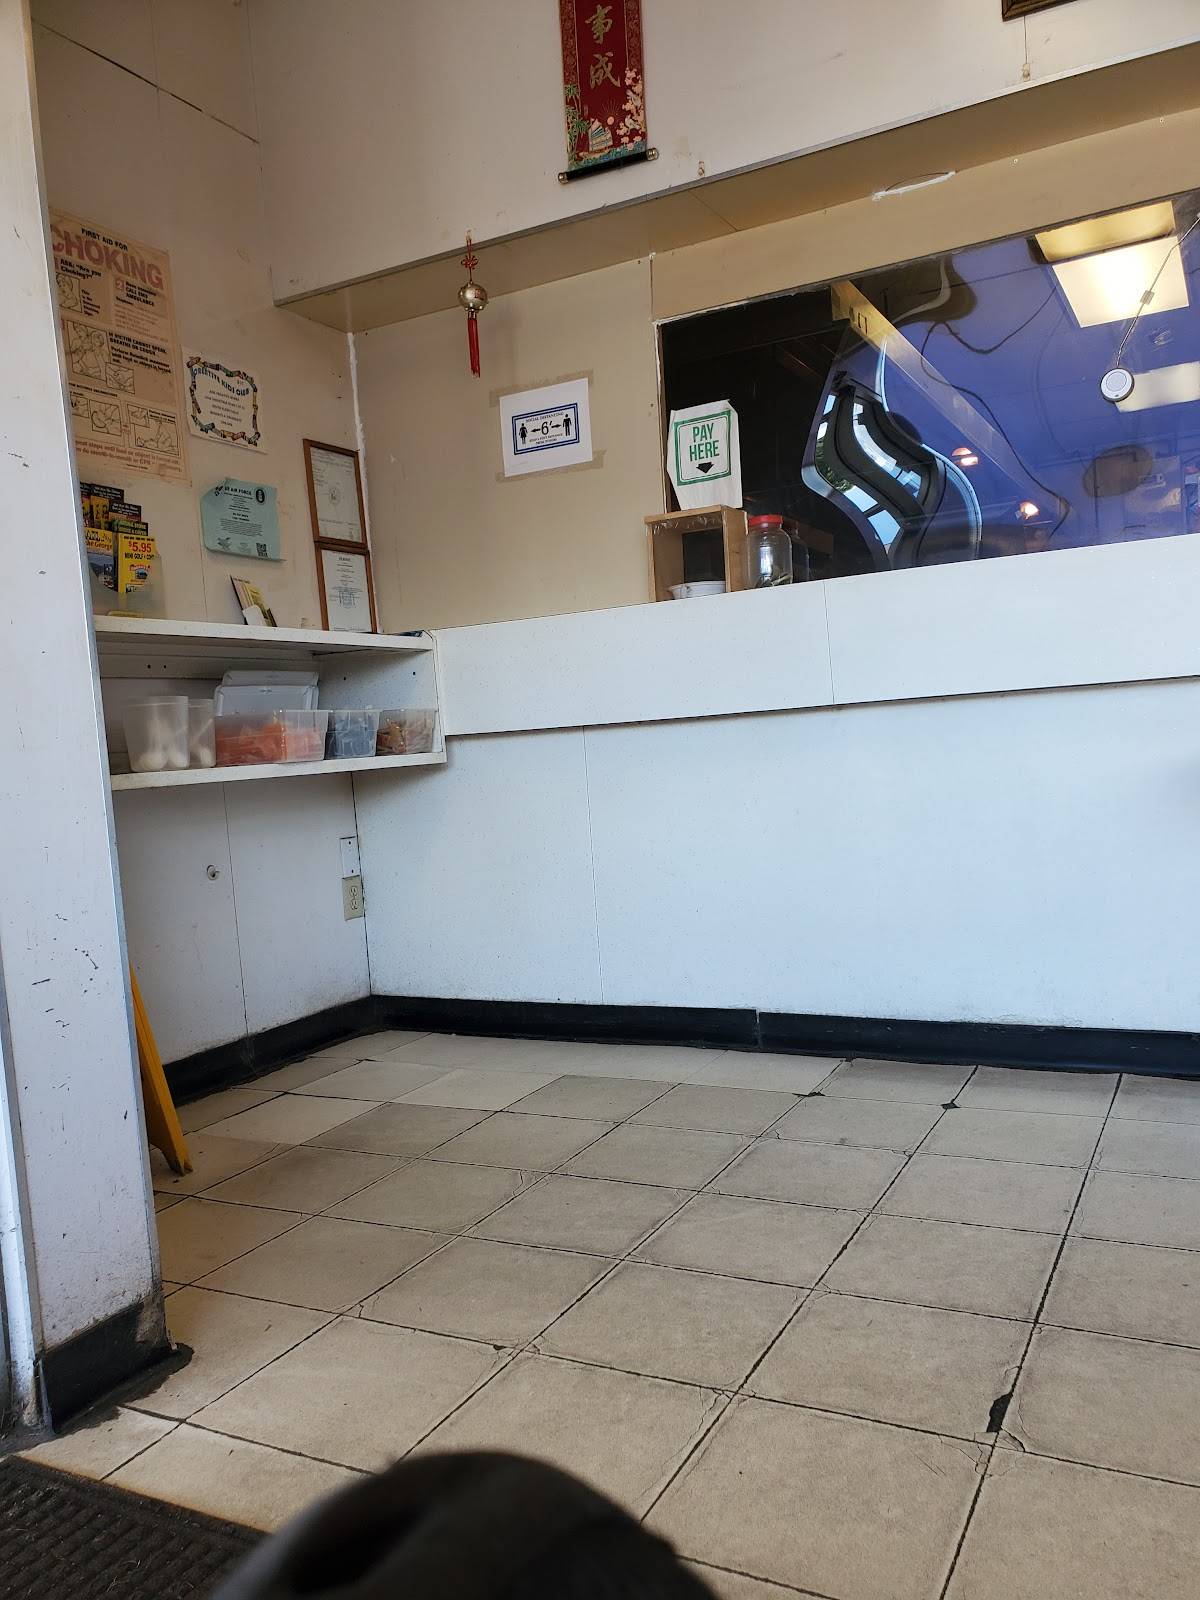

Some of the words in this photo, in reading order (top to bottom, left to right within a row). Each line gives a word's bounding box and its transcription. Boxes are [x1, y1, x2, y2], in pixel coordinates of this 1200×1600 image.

[81, 227, 100, 241] FIRST
[102, 235, 113, 246] AID
[115, 241, 128, 252] FOR
[114, 277, 124, 290] 2
[692, 422, 714, 443] PAY
[689, 439, 720, 462] HERE
[128, 540, 152, 554] $5.95
